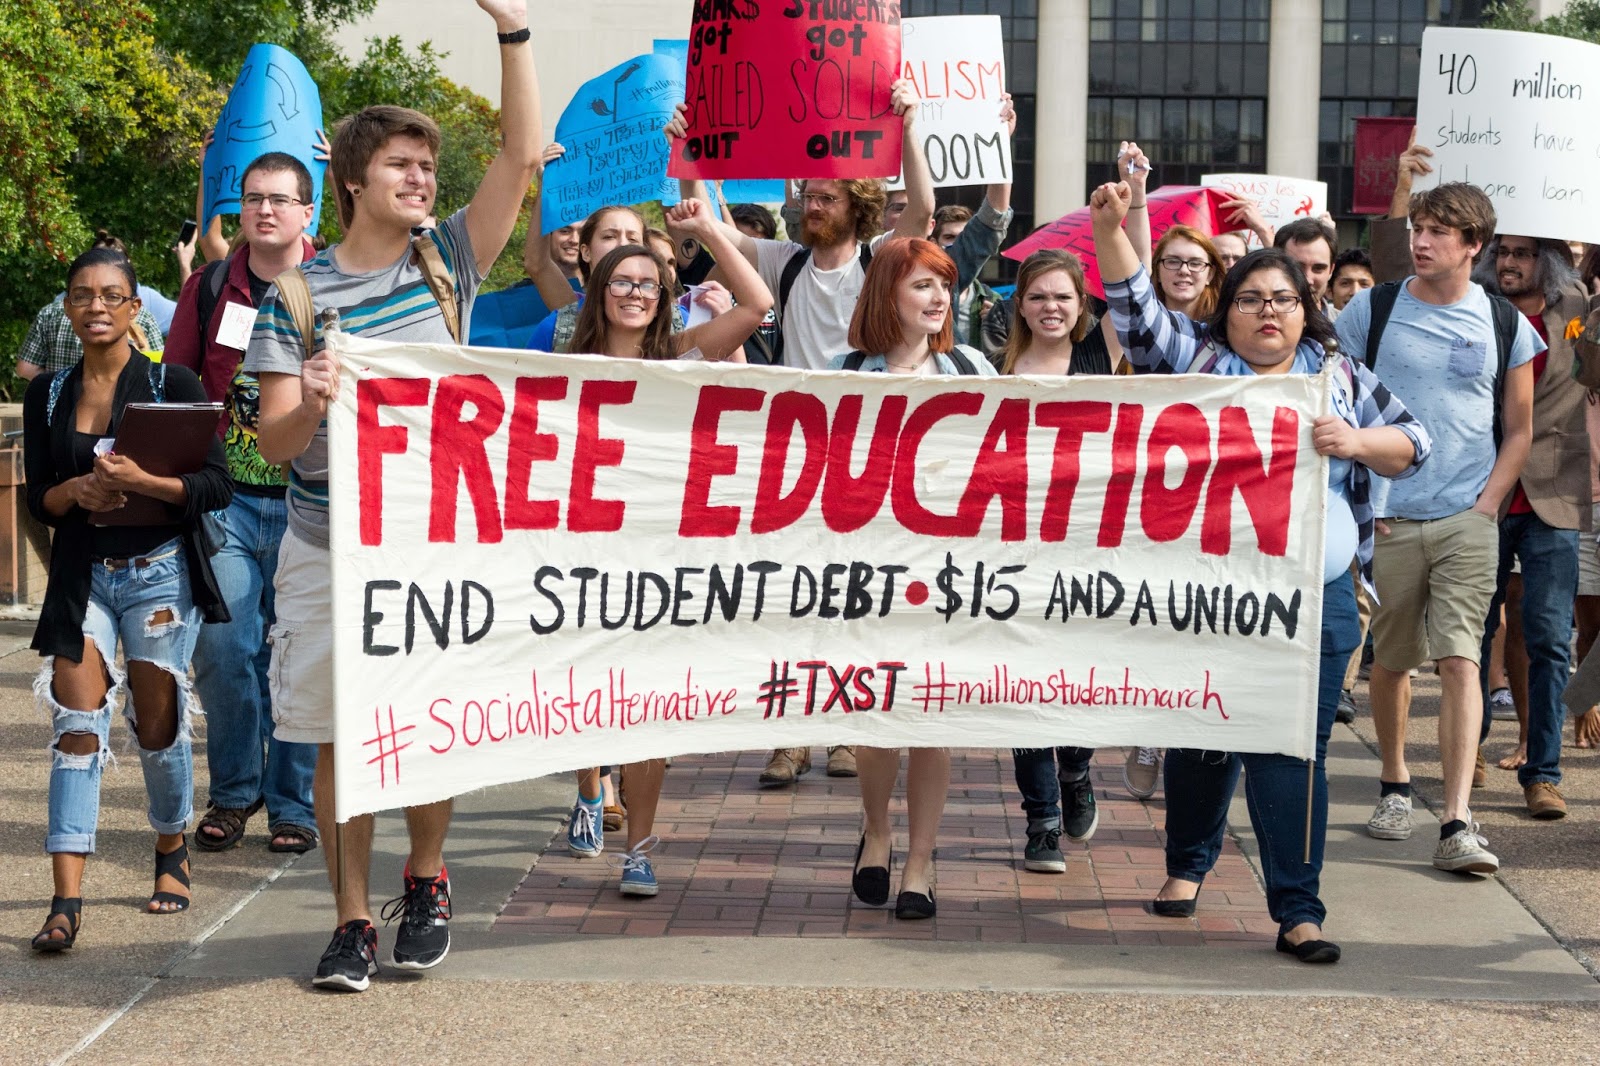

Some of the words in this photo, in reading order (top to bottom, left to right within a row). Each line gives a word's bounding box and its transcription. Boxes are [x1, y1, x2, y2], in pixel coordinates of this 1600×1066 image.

[692, 22, 732, 66] got
[806, 24, 868, 61] got
[685, 61, 764, 131] BAILED
[788, 58, 893, 123] SOLD
[1438, 53, 1477, 95] 40
[1512, 62, 1582, 100] million
[921, 101, 945, 122] MY
[1534, 122, 1576, 152] have
[1483, 183, 1516, 199] one
[1543, 176, 1584, 205] loan
[356, 373, 637, 547] FREE
[678, 384, 1299, 557] EDUCATION
[363, 579, 494, 656] END
[530, 560, 782, 636] STUDENT
[935, 551, 1028, 624] $15
[1044, 570, 1126, 624] AND
[1129, 579, 1158, 627] A
[1167, 579, 1302, 640] UNION
[757, 659, 908, 720] #TXST
